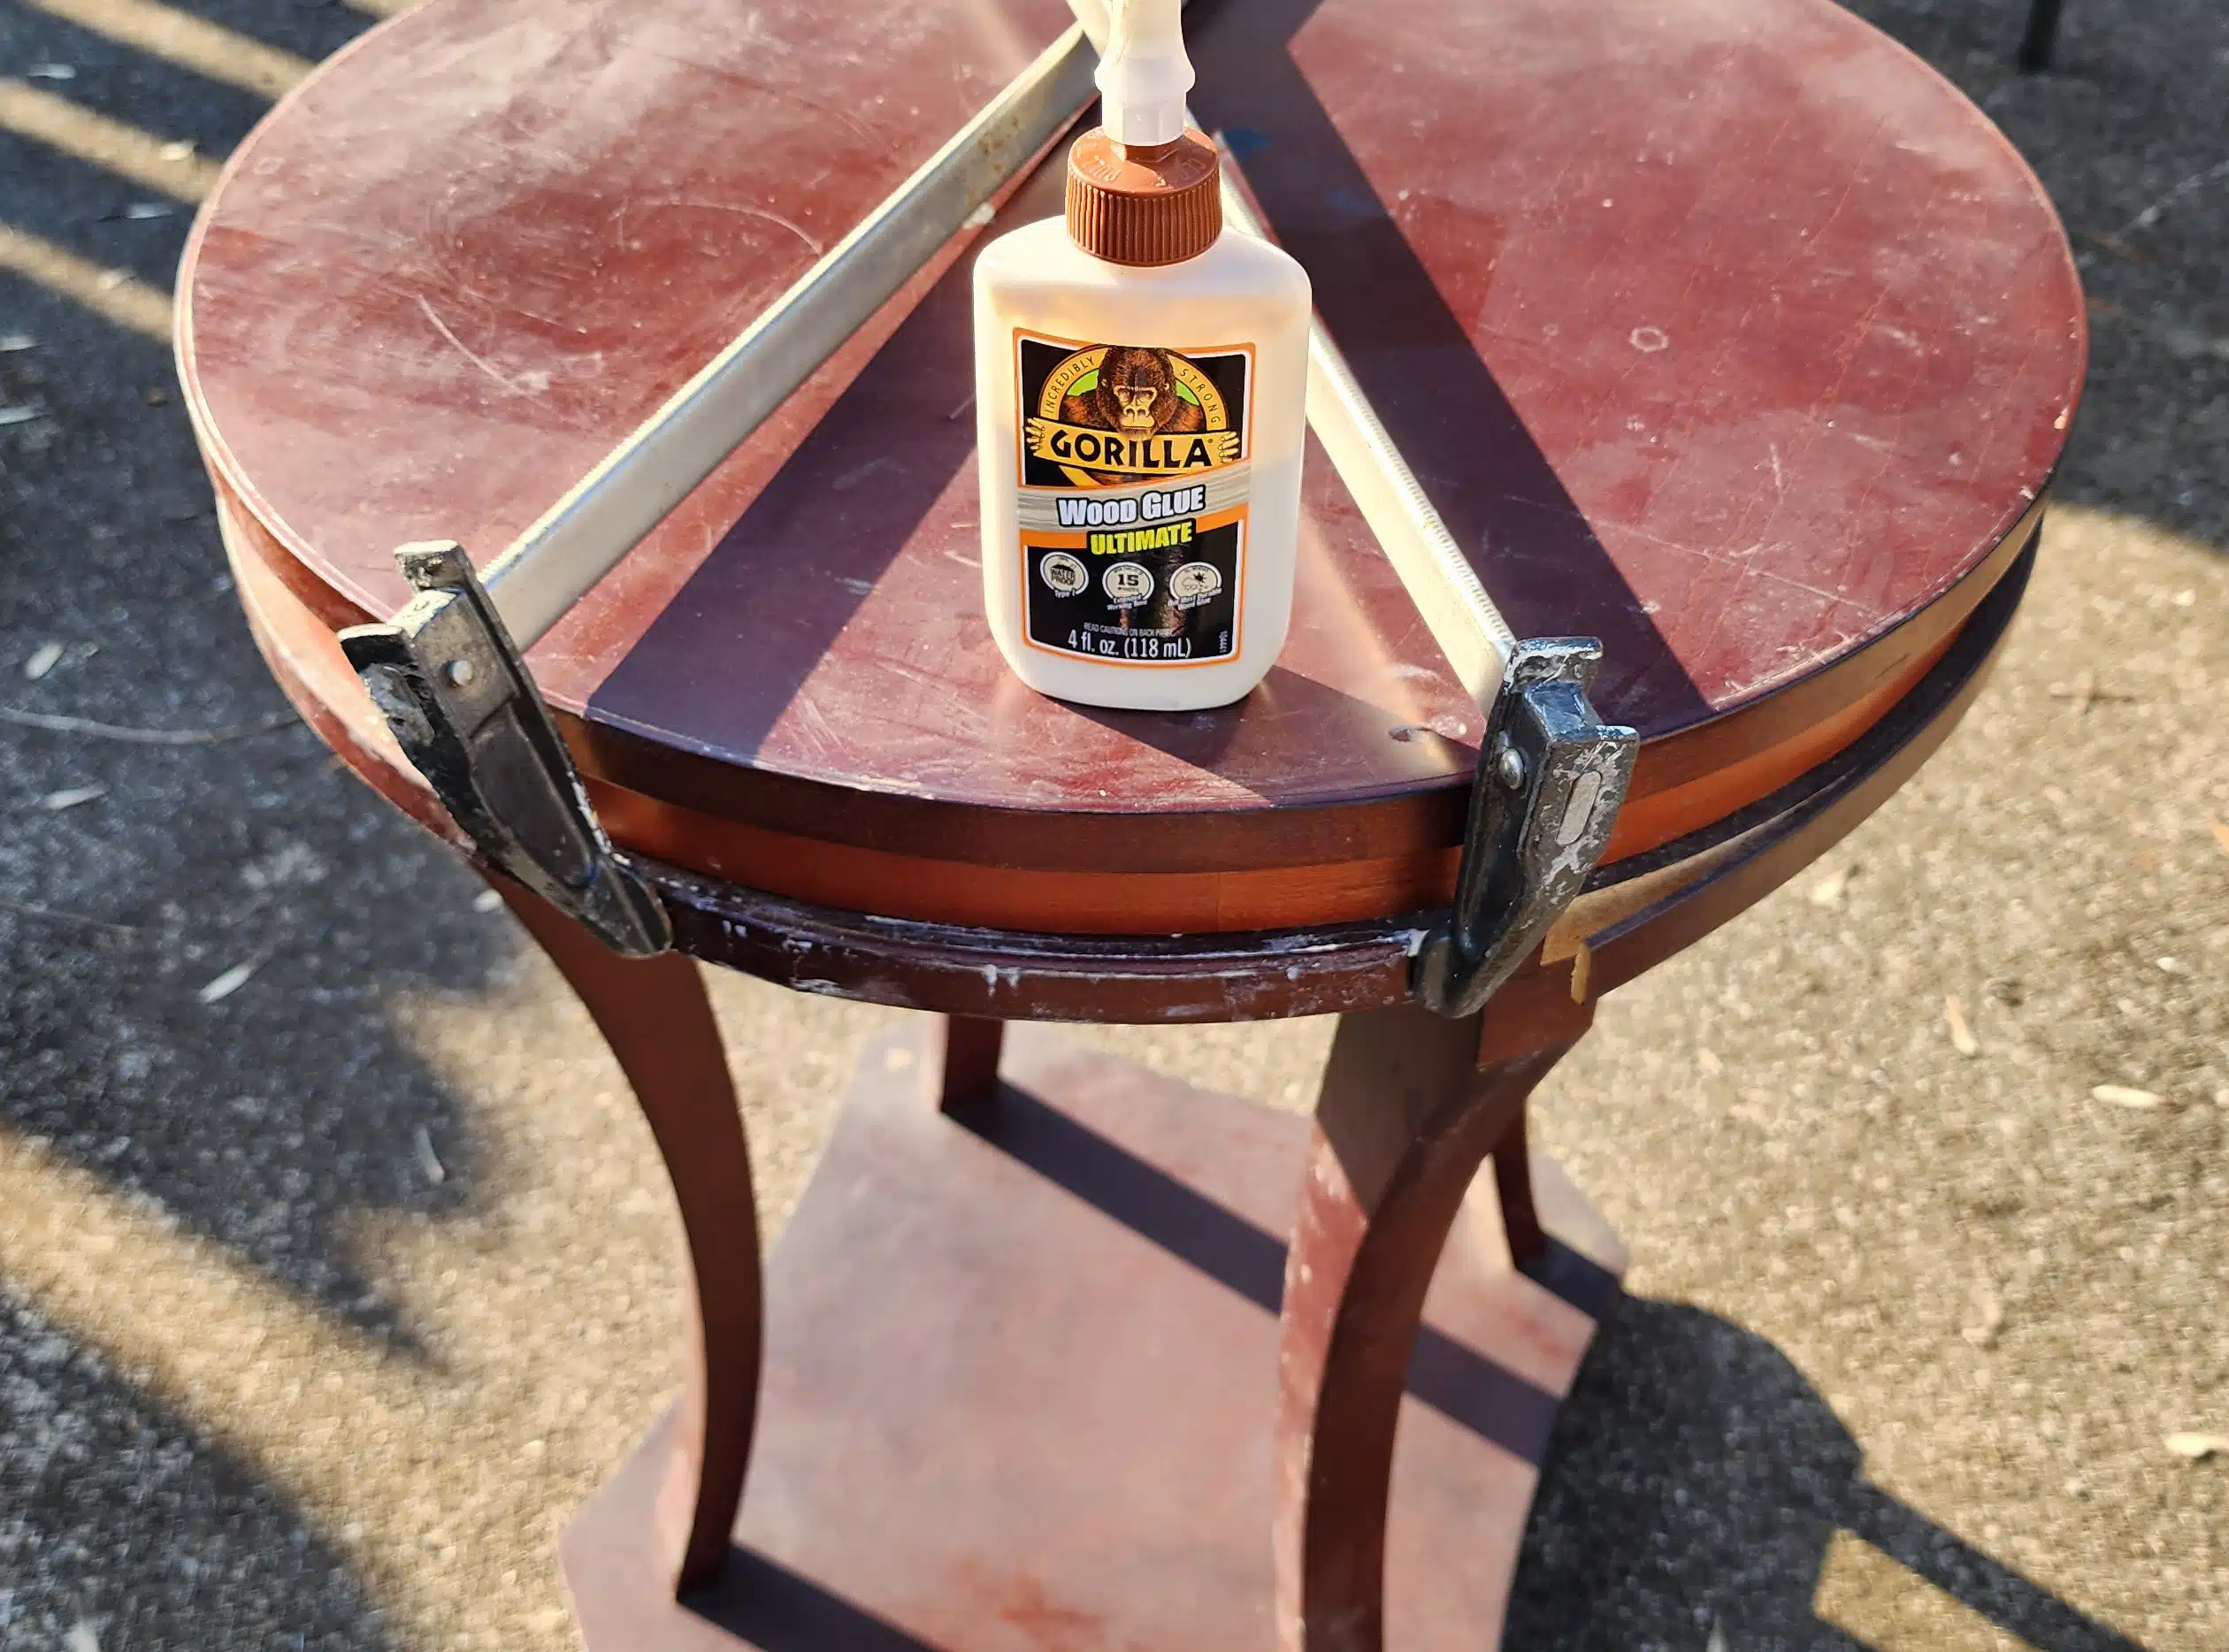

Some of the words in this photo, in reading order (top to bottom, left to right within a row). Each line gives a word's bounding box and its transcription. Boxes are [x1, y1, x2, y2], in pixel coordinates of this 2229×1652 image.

[1044, 356, 1095, 414] INCREDIBLY
[1179, 368, 1221, 424] STRONG
[1050, 429, 1213, 469] GORILLA
[1090, 521, 1193, 555] ULTIMATE
[1118, 573, 1139, 586] 15
[1068, 629, 1078, 649] 4
[1081, 631, 1096, 652] fl.
[1099, 639, 1120, 656] oz.
[1123, 637, 1159, 658] (118
[1163, 637, 1191, 658] mL)
